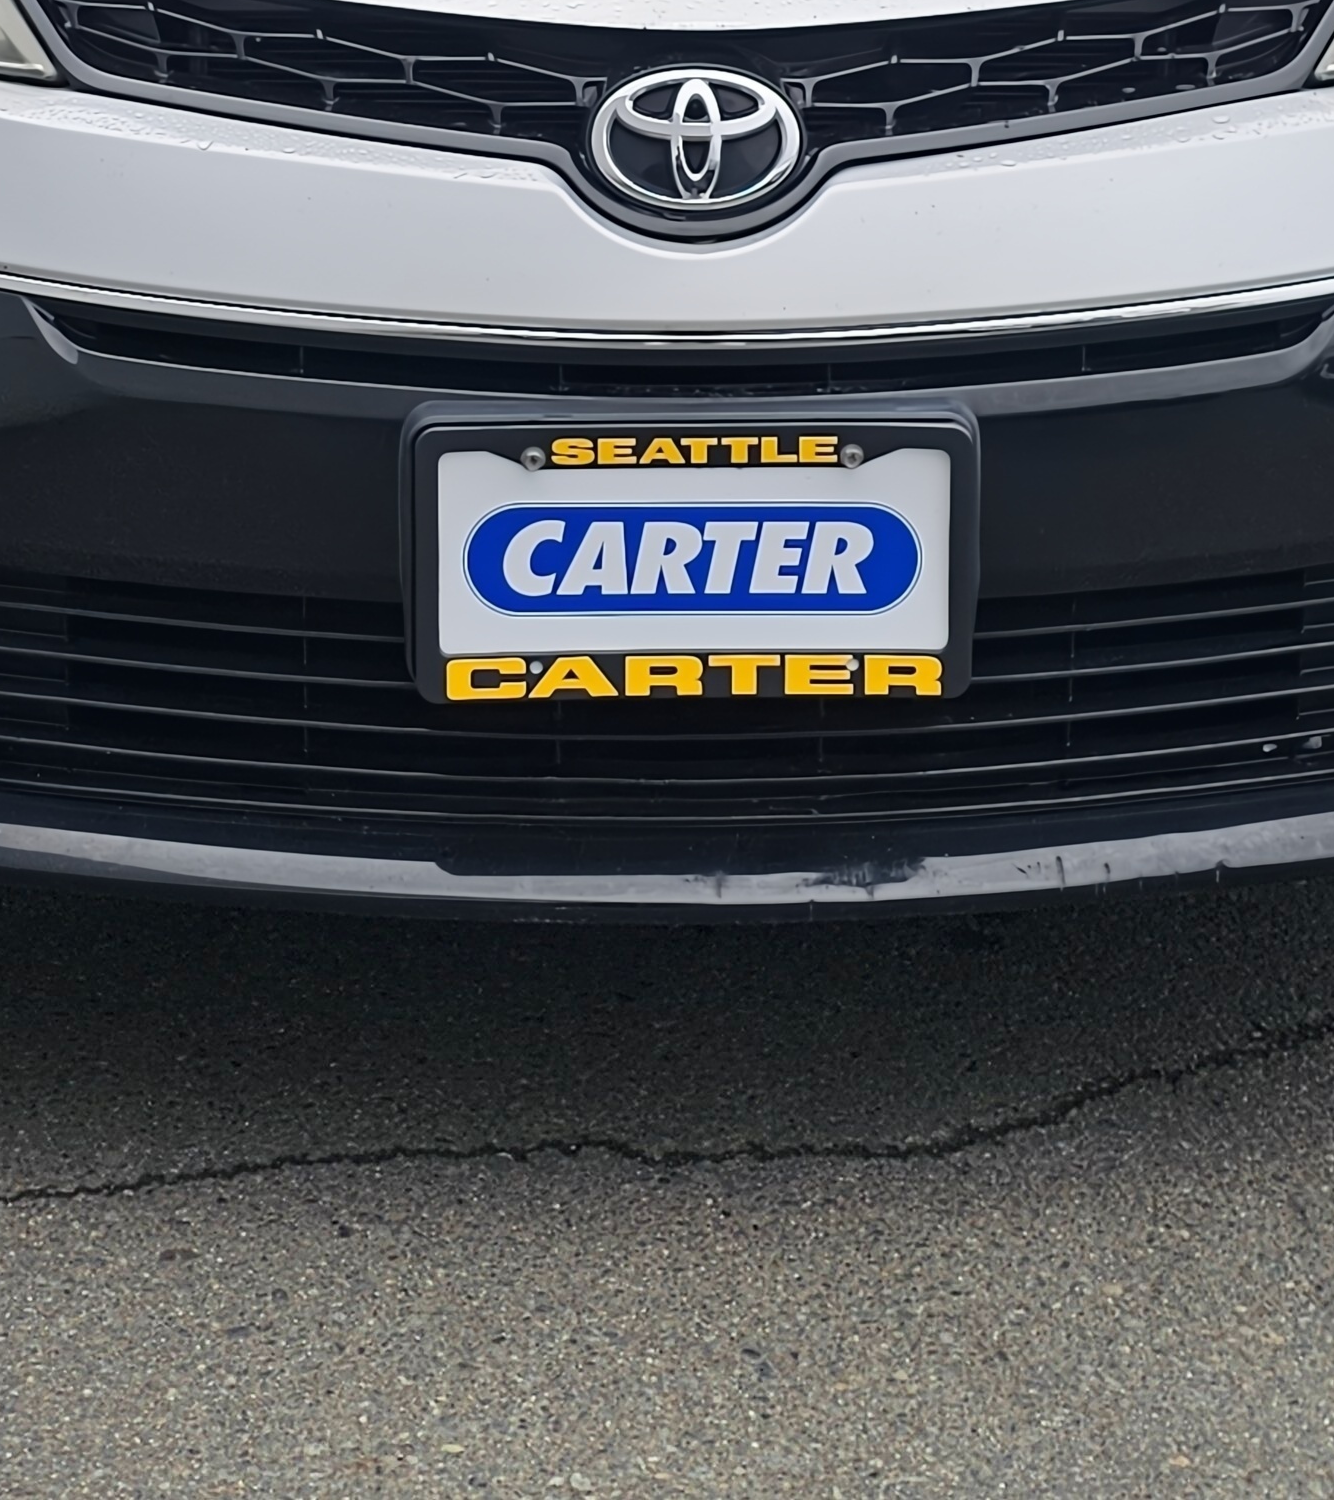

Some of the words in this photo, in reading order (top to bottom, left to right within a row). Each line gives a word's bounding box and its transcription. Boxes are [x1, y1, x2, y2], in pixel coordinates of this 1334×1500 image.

[551, 436, 838, 466] SEATTLE
[502, 519, 874, 597] CARTER
[445, 654, 943, 701] CARTER
